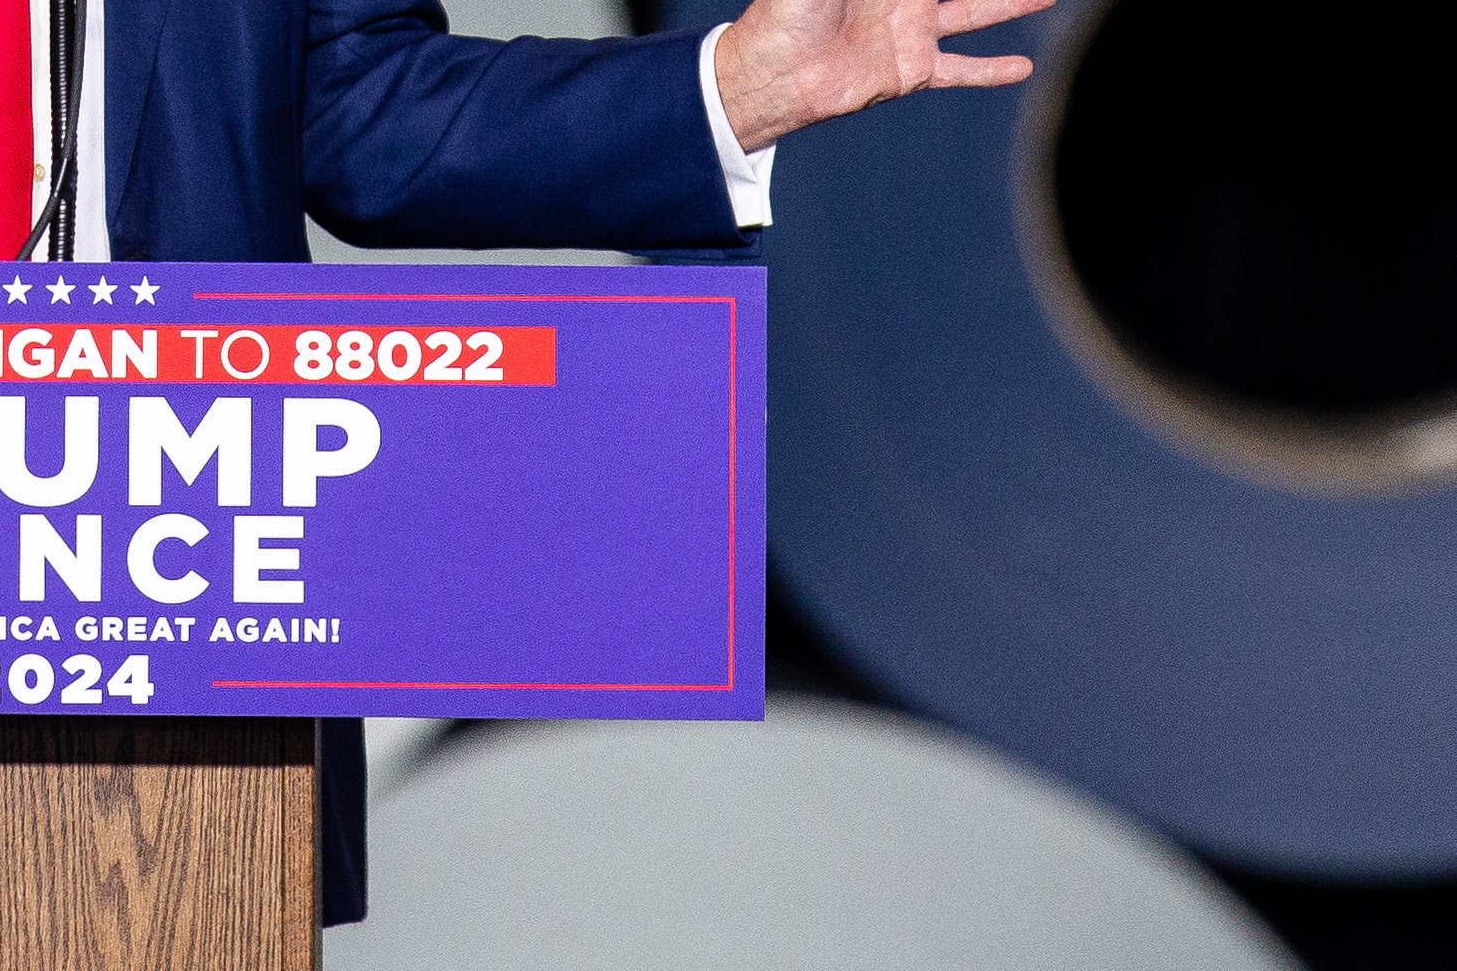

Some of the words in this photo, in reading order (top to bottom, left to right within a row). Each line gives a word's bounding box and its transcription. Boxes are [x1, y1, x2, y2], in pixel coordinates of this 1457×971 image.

[180, 329, 270, 380] TO
[293, 330, 504, 381] 88022
[74, 616, 196, 642] GREAT
[209, 617, 340, 643] AGAIN!
